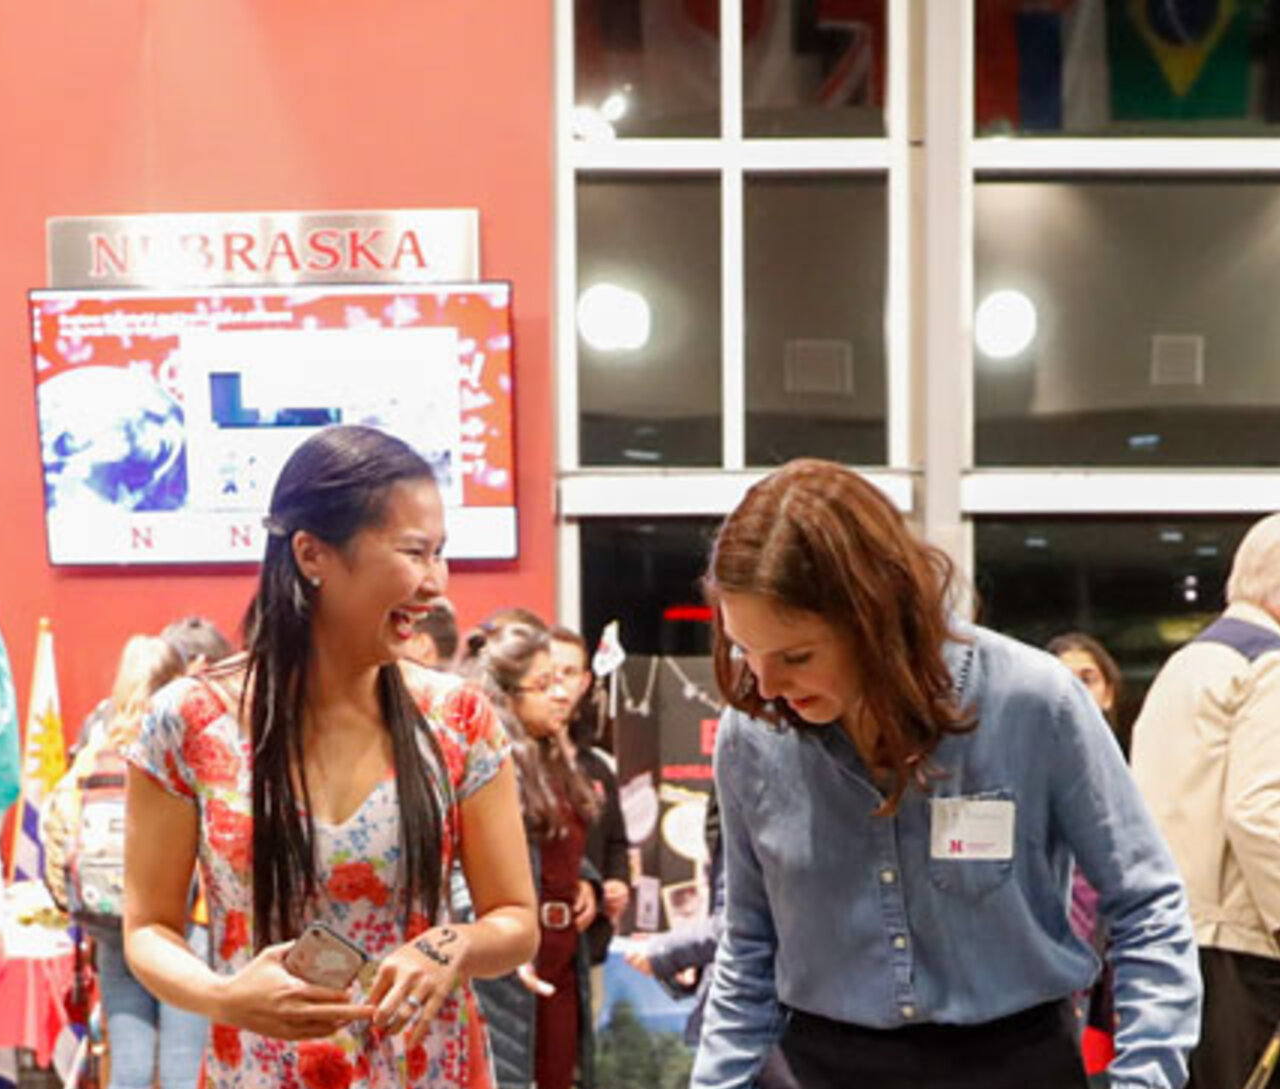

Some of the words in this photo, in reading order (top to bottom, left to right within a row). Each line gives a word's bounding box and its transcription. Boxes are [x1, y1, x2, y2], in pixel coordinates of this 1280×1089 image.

[89, 228, 428, 277] NBRASKA
[131, 526, 154, 549] N
[230, 524, 253, 548] N
